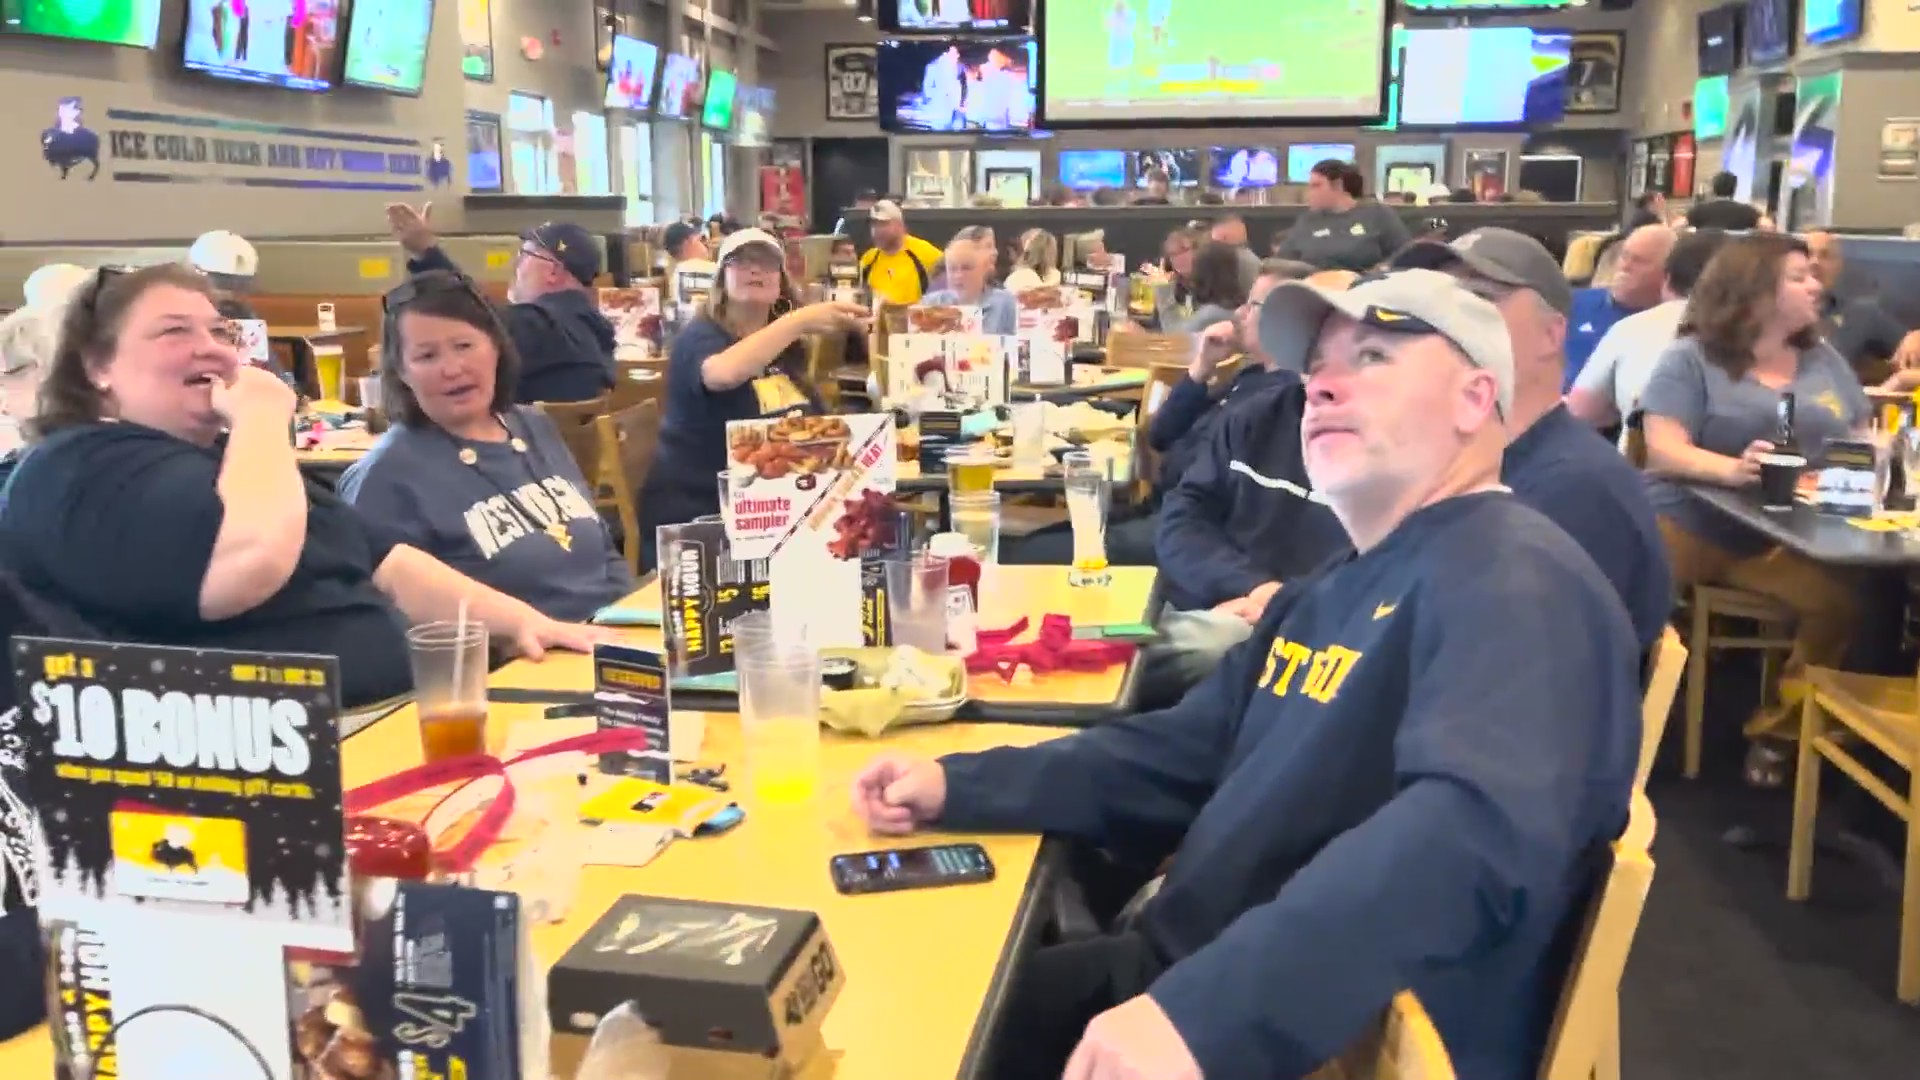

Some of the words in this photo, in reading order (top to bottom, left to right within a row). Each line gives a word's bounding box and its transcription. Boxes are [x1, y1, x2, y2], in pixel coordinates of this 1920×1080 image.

[110, 131, 148, 160] ICE
[154, 135, 207, 162] COLD
[860, 443, 883, 468] HEAT
[735, 497, 790, 516] ultimate
[735, 515, 790, 532] sampler
[681, 549, 699, 597] HOUR
[684, 599, 703, 652] HAPPY
[30, 680, 118, 761] $10
[121, 687, 312, 777] BONUS
[392, 992, 477, 1048] $4
